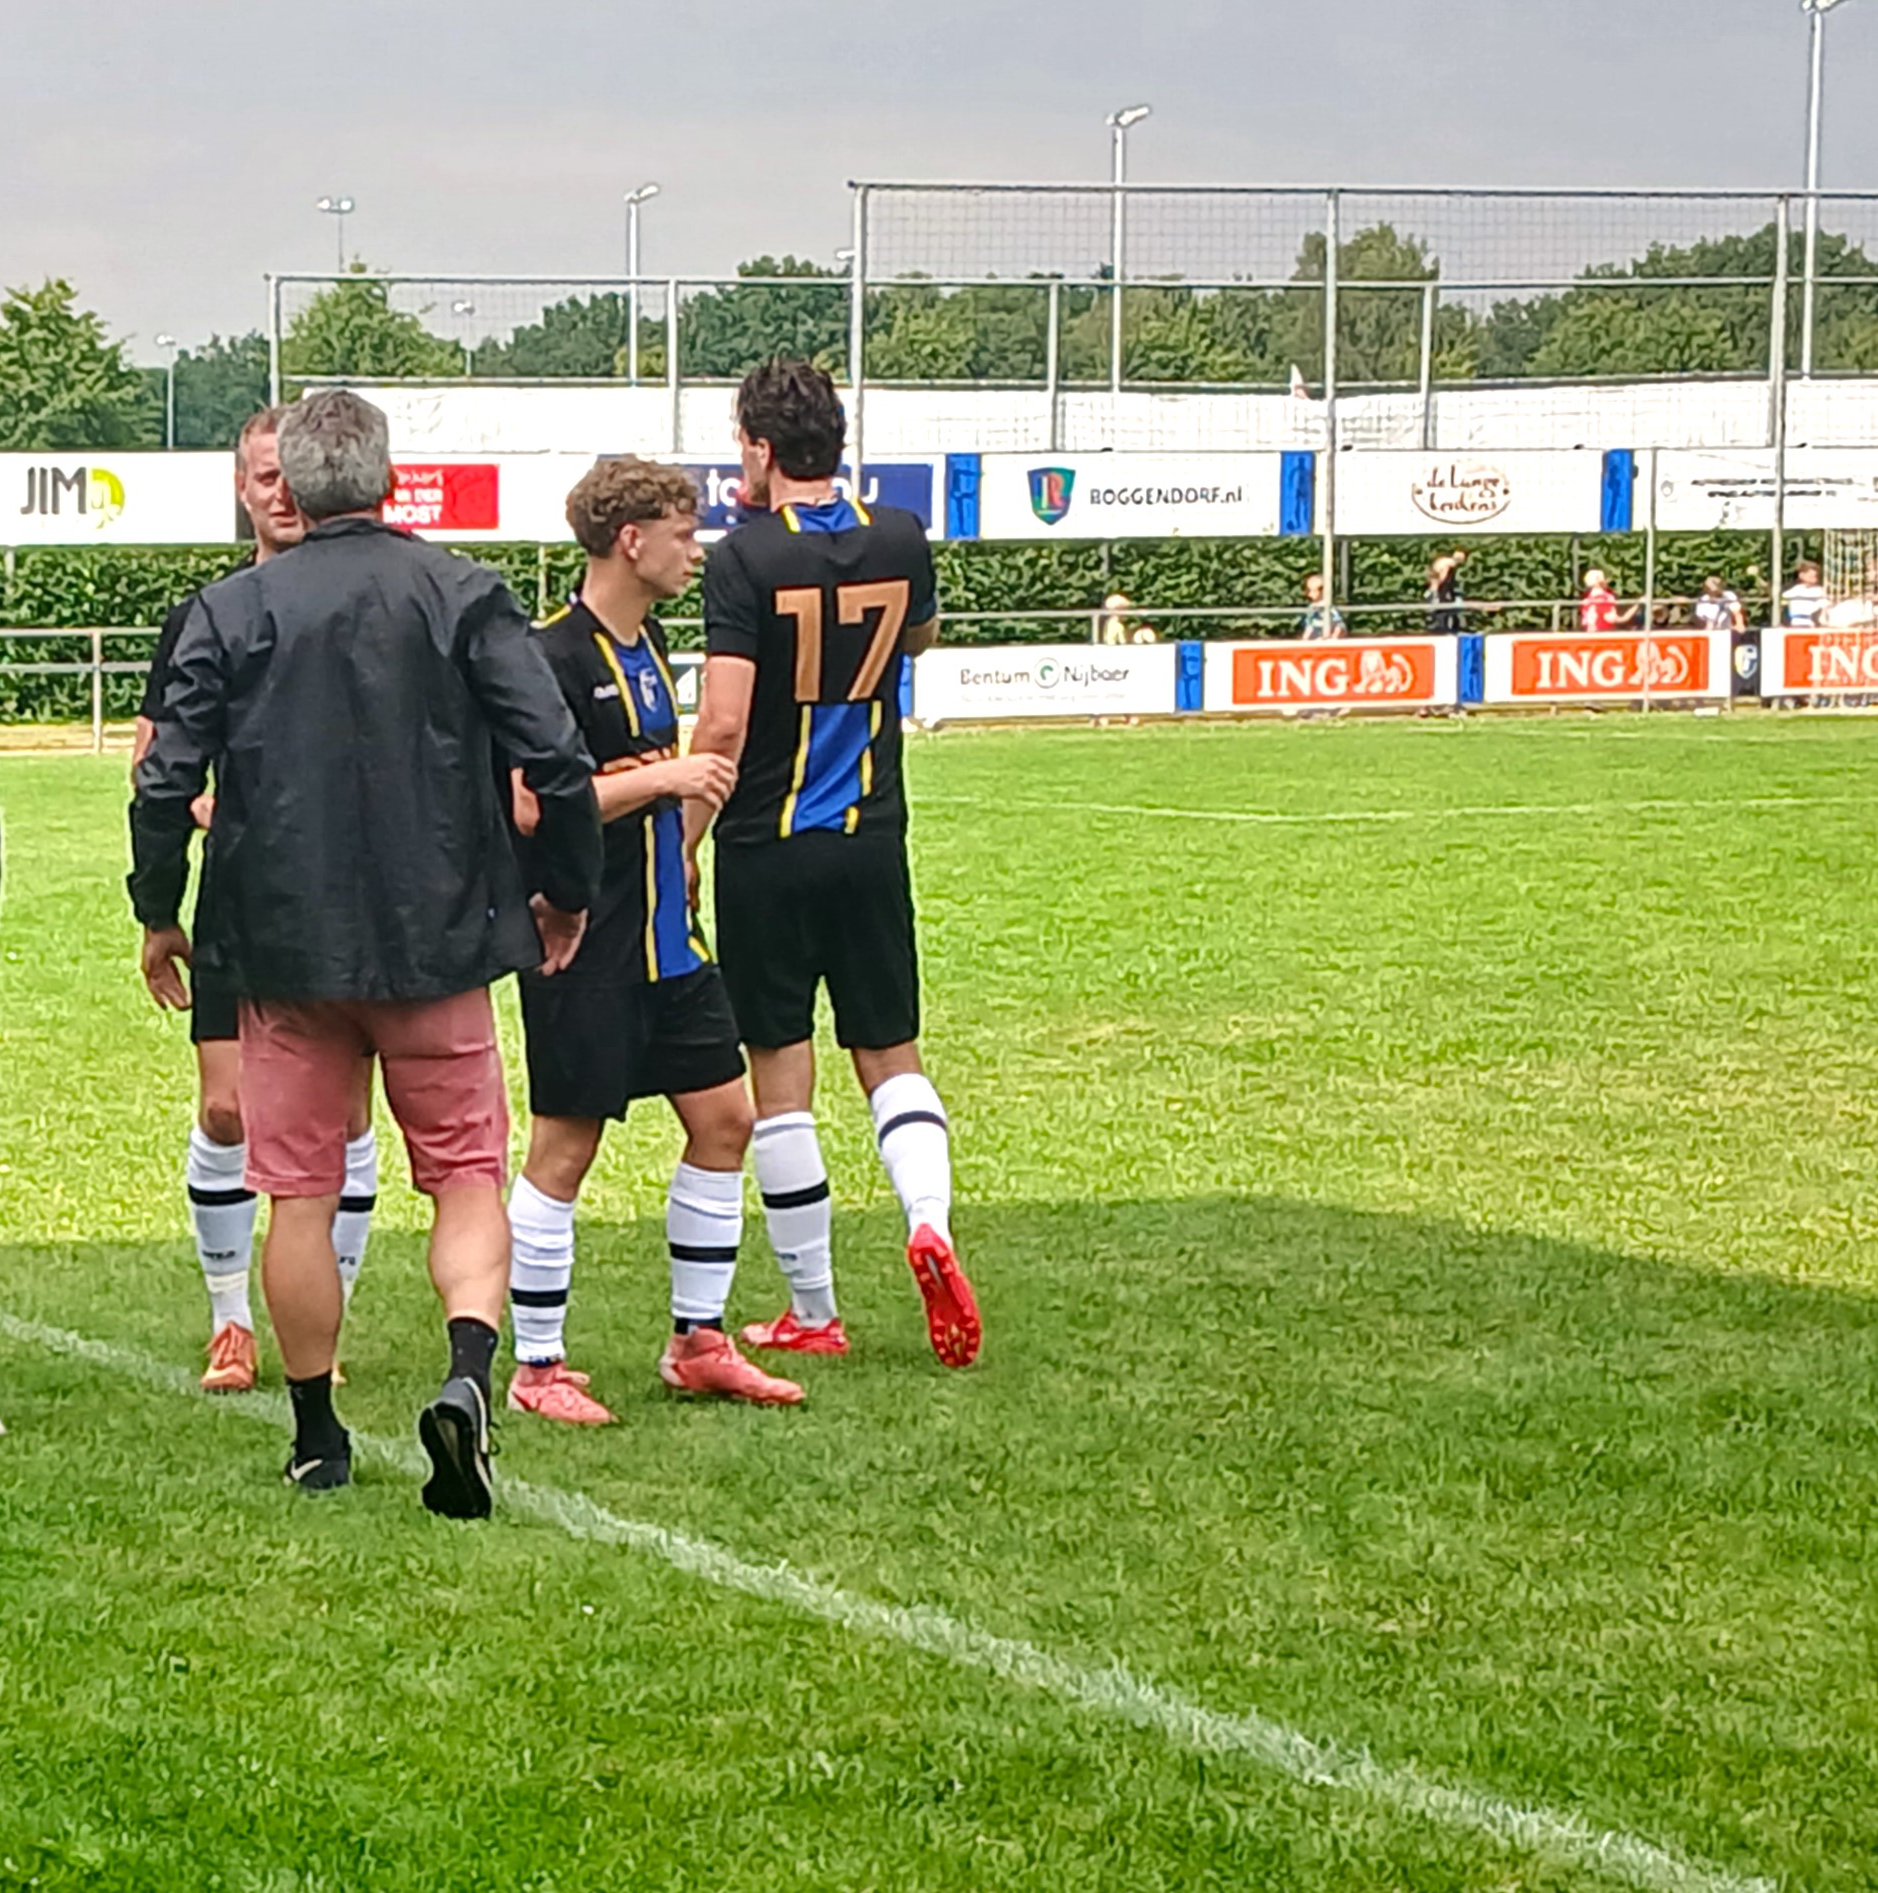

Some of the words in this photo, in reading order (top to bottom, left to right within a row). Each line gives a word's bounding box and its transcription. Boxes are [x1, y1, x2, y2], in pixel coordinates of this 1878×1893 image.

[775, 580, 910, 703] 17
[960, 668, 1031, 686] Bentum
[1257, 658, 1351, 698] ING
[1535, 650, 1626, 689] ING
